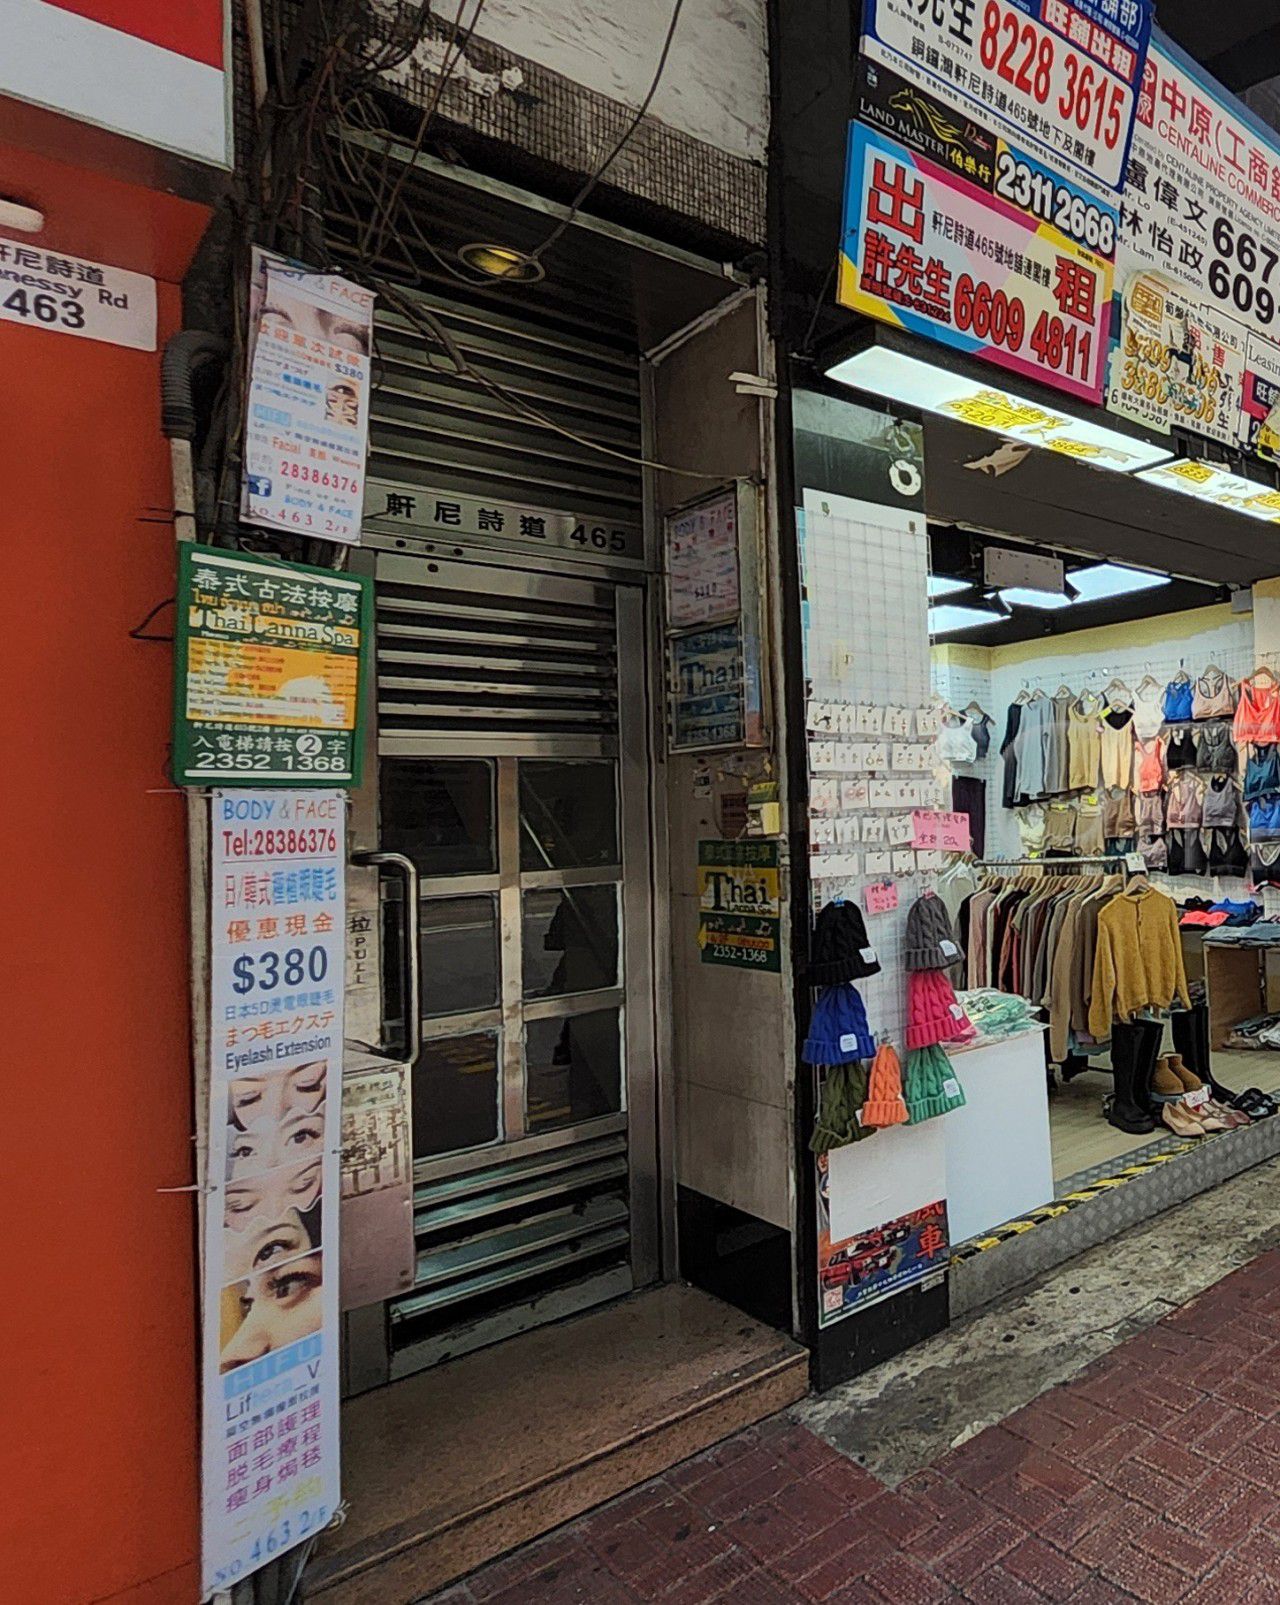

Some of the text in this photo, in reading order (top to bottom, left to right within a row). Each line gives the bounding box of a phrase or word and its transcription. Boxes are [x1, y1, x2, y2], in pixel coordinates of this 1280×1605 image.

[979, 0, 1054, 105] 8228
[1057, 53, 1126, 150] 3615
[860, 97, 945, 156] LAND MASTER
[1157, 119, 1226, 183] CENTALINE
[867, 158, 925, 245] 出
[996, 152, 1118, 256] 2311 2668
[862, 226, 952, 310] 許先生
[2, 287, 86, 329] 463
[98, 287, 129, 311] Rd
[1051, 254, 1097, 327] 租
[953, 272, 1026, 353] 6609
[1029, 309, 1093, 383] 4811
[281, 460, 359, 494] 28386376
[278, 508, 313, 527] 463
[385, 492, 548, 540] 軒尼詩道
[569, 523, 628, 551] 465
[190, 567, 360, 613] 泰式古法按摩
[321, 625, 355, 646] Spa
[194, 752, 346, 772] 2352 1368
[222, 798, 338, 821] BODY & FACE
[222, 828, 337, 857] Tel:28386376
[704, 871, 772, 912] Thai
[226, 911, 335, 944] 優惠現金
[349, 915, 372, 935] 拉
[231, 944, 329, 996] $380
[353, 936, 370, 985] PULL
[225, 1034, 332, 1073] Eyelash Extension
[913, 1223, 947, 1260] 車
[226, 1399, 322, 1464] 面部護理
[249, 1519, 292, 1564] 463
